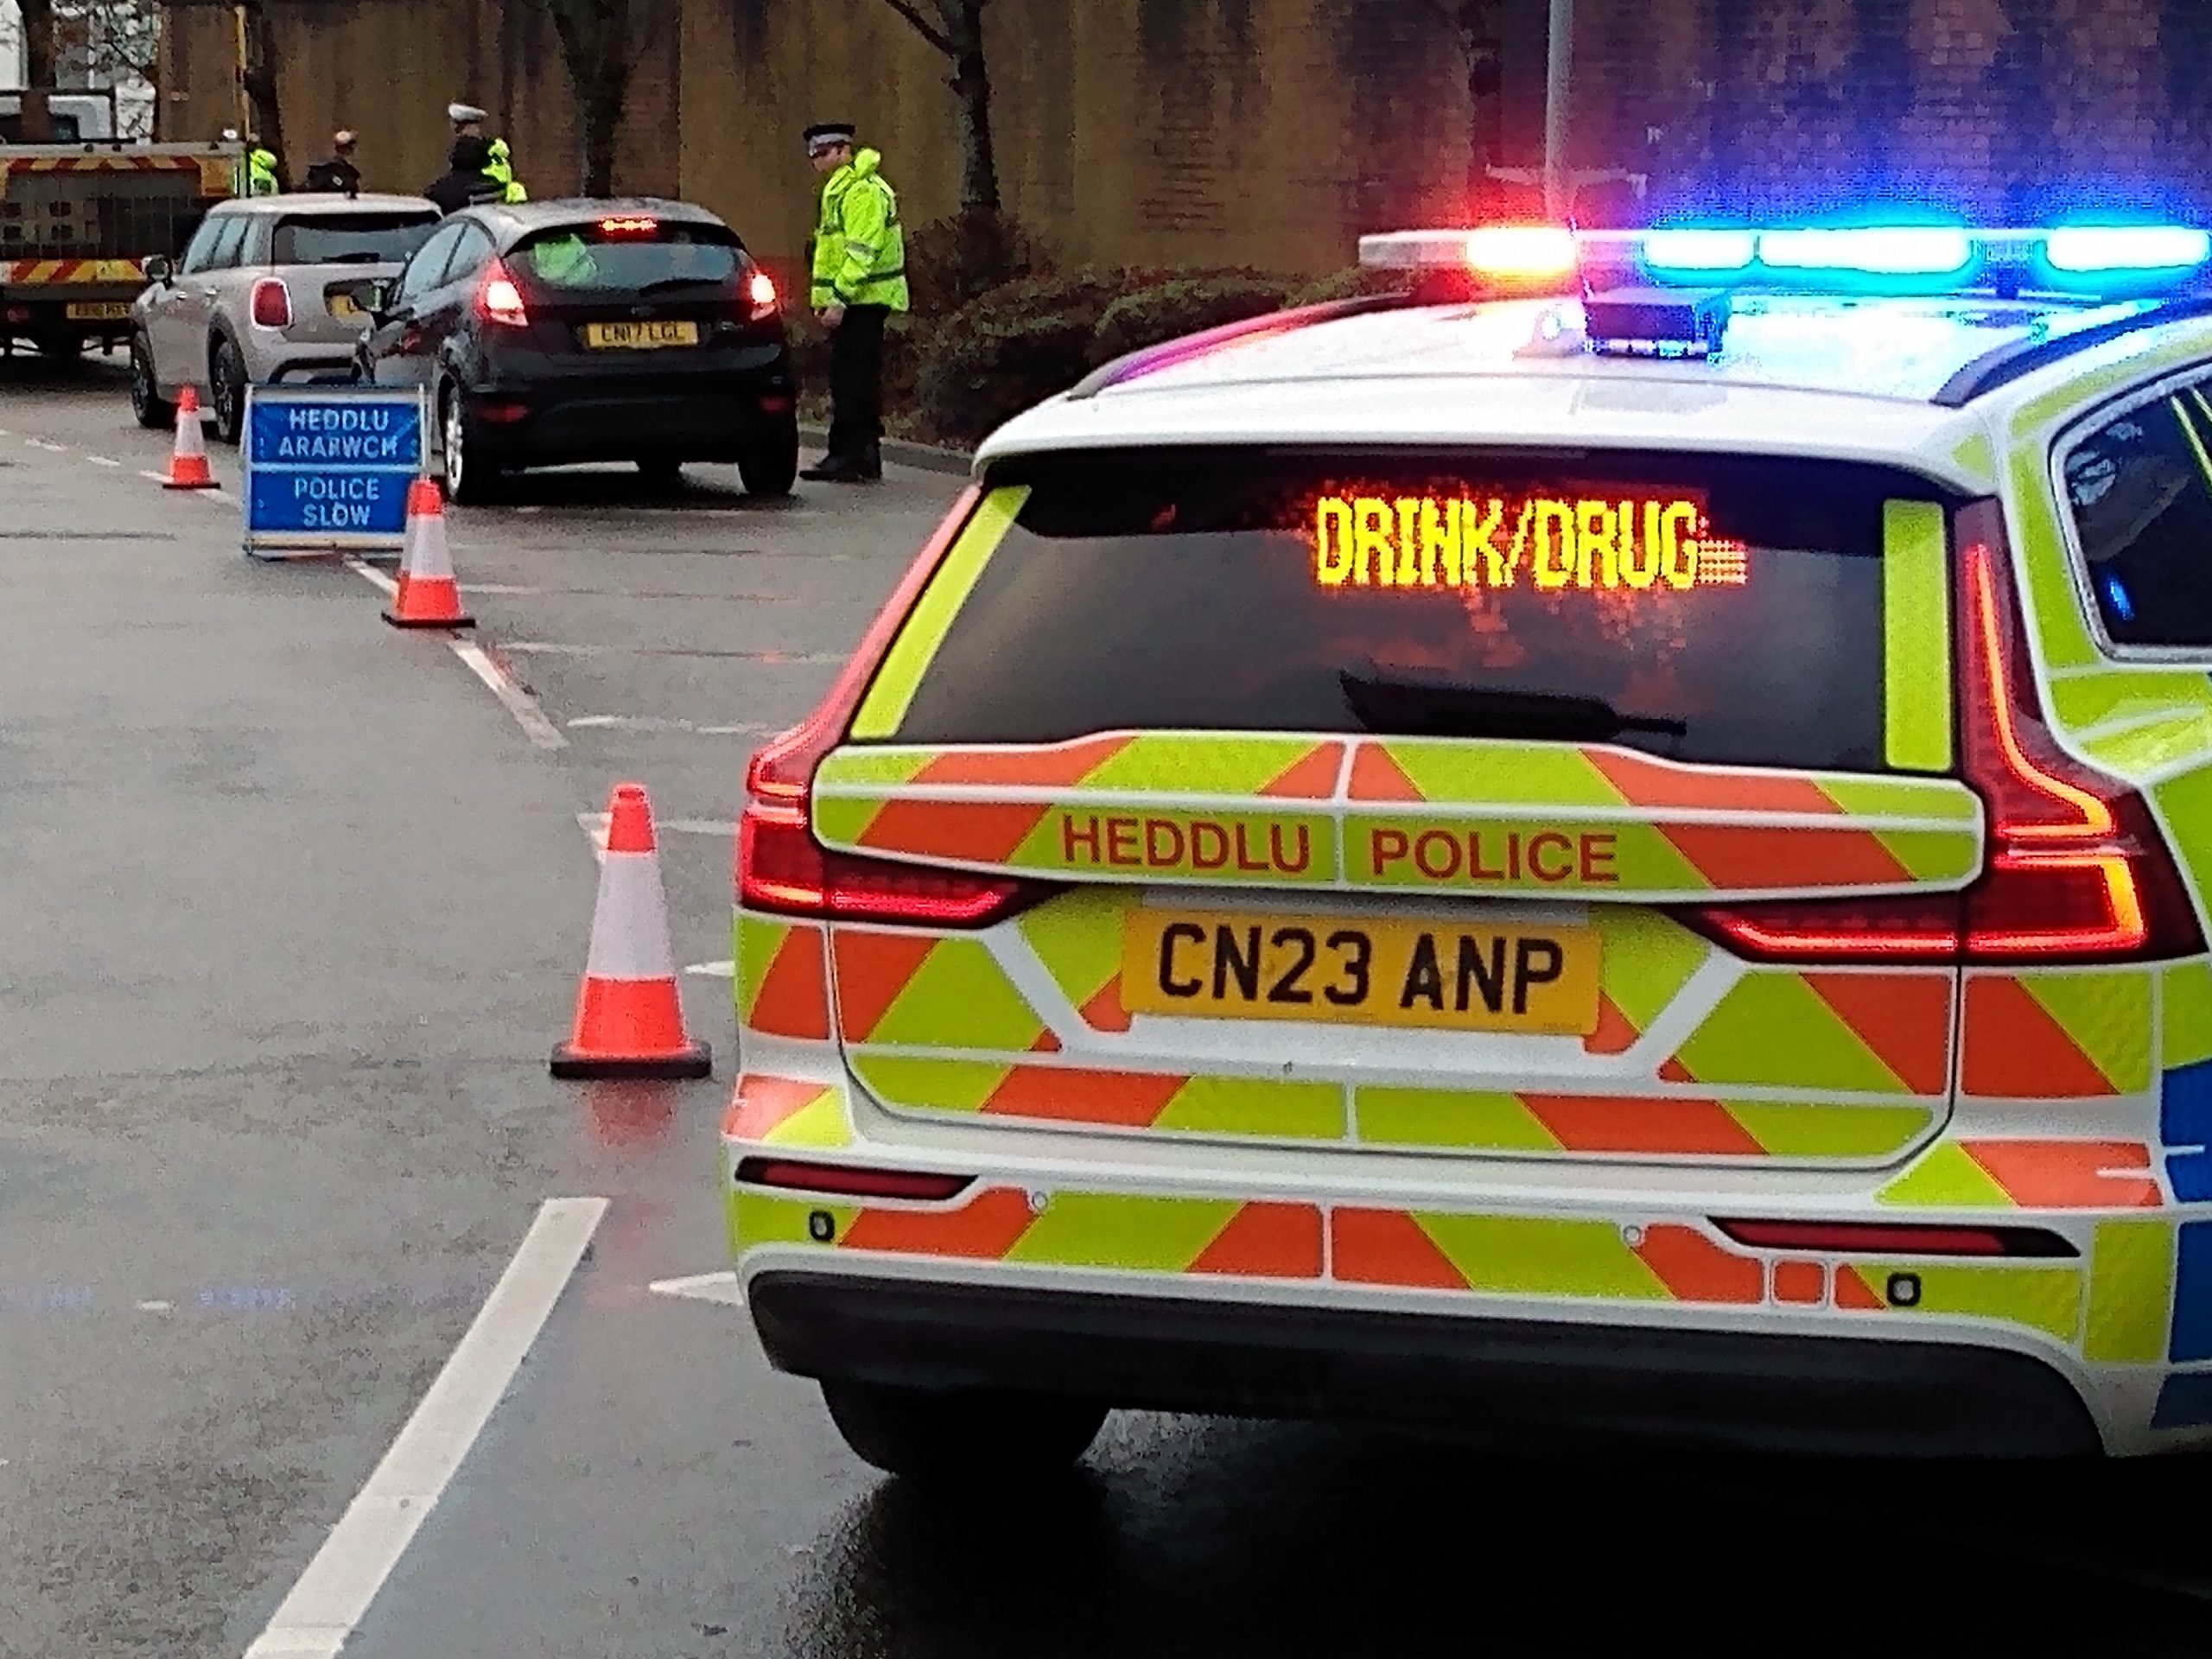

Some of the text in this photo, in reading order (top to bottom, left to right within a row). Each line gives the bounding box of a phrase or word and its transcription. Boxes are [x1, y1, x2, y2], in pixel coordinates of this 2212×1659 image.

[289, 408, 389, 432] HEDDLU
[294, 477, 380, 500] POLICE
[303, 503, 371, 526] SLOW
[1317, 496, 1699, 589] DRINK/DRUG
[1063, 815, 1619, 883] HEDDLU POLICE
[1158, 922, 1564, 1015] CN23 ANP
